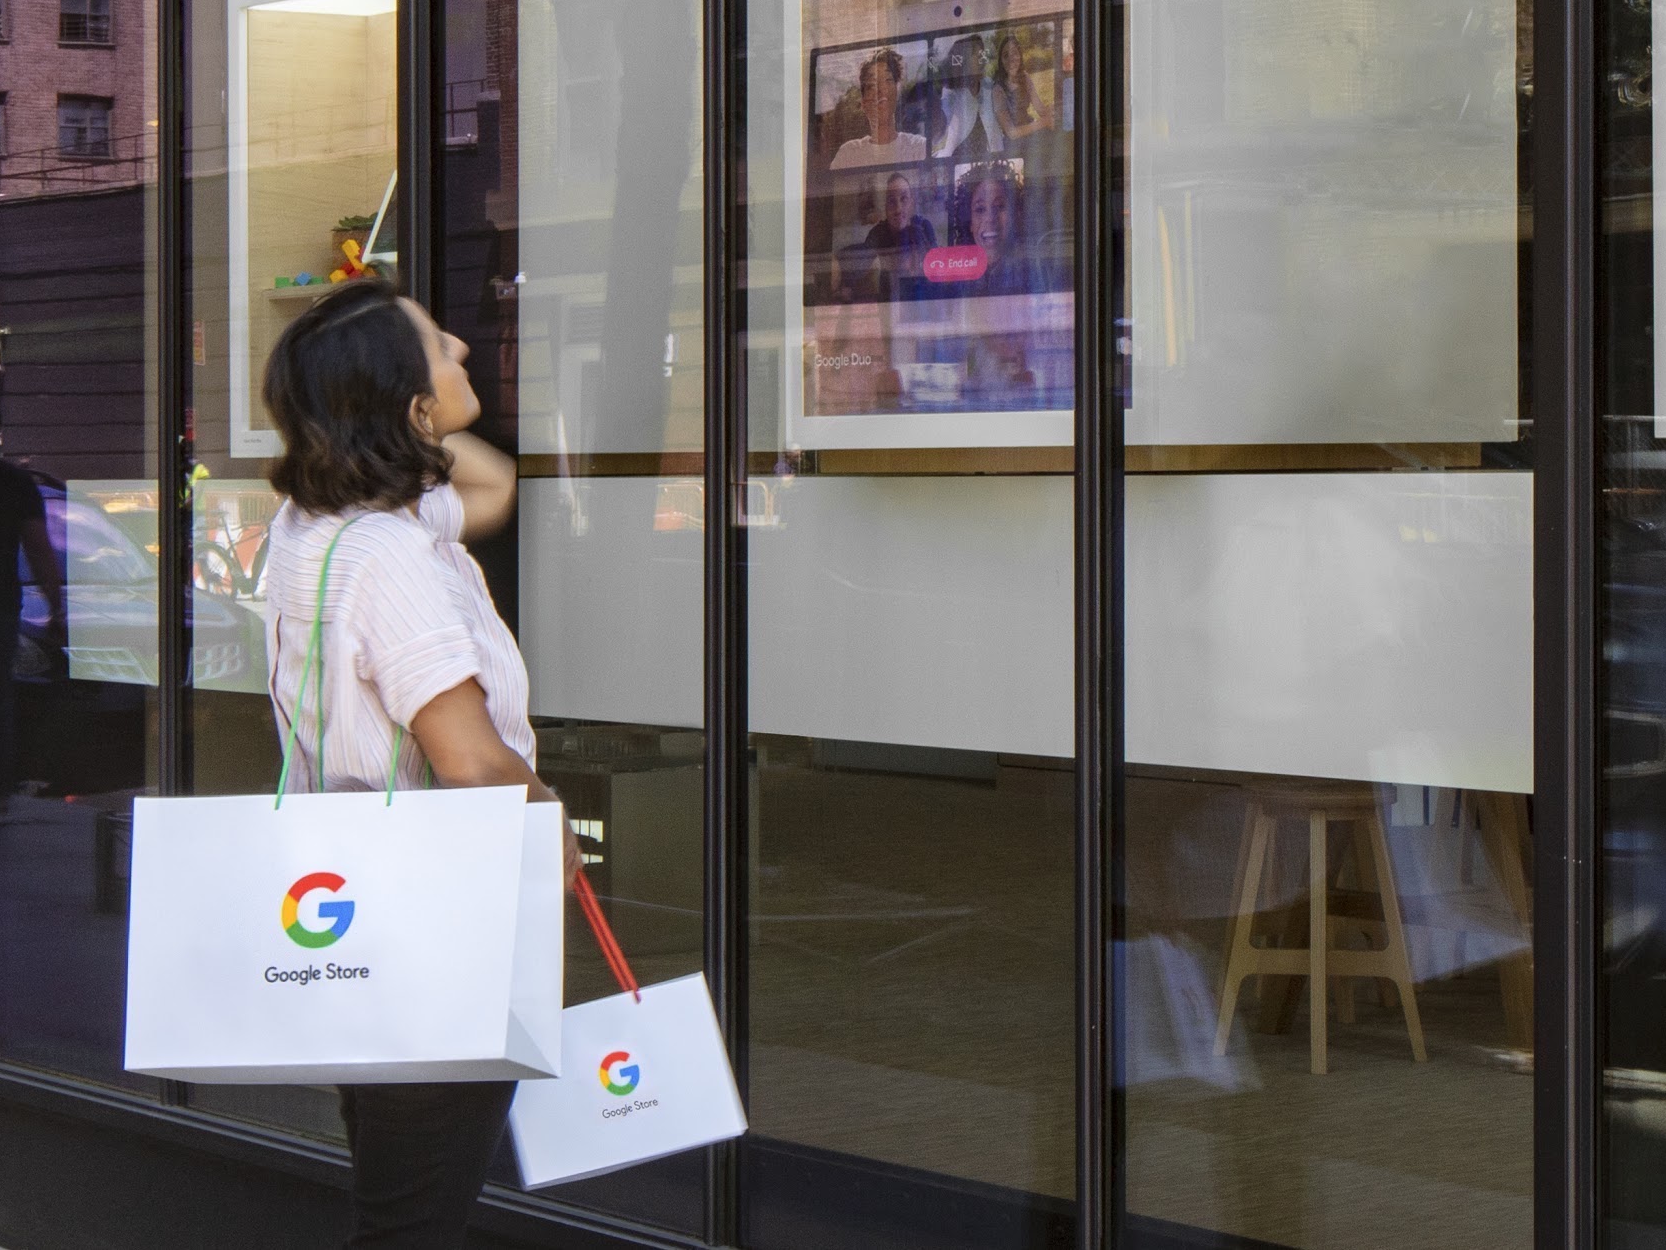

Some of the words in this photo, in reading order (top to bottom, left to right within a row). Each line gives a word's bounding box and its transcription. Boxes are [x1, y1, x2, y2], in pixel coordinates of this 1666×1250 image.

[948, 258, 963, 268] End
[964, 256, 978, 268] call
[814, 353, 849, 370] Google
[851, 352, 872, 366] Duo
[281, 871, 356, 949] G
[264, 964, 322, 986] Google
[325, 962, 370, 980] Store
[599, 1050, 640, 1096] G
[601, 1103, 633, 1119] Google
[633, 1098, 659, 1111] Store
